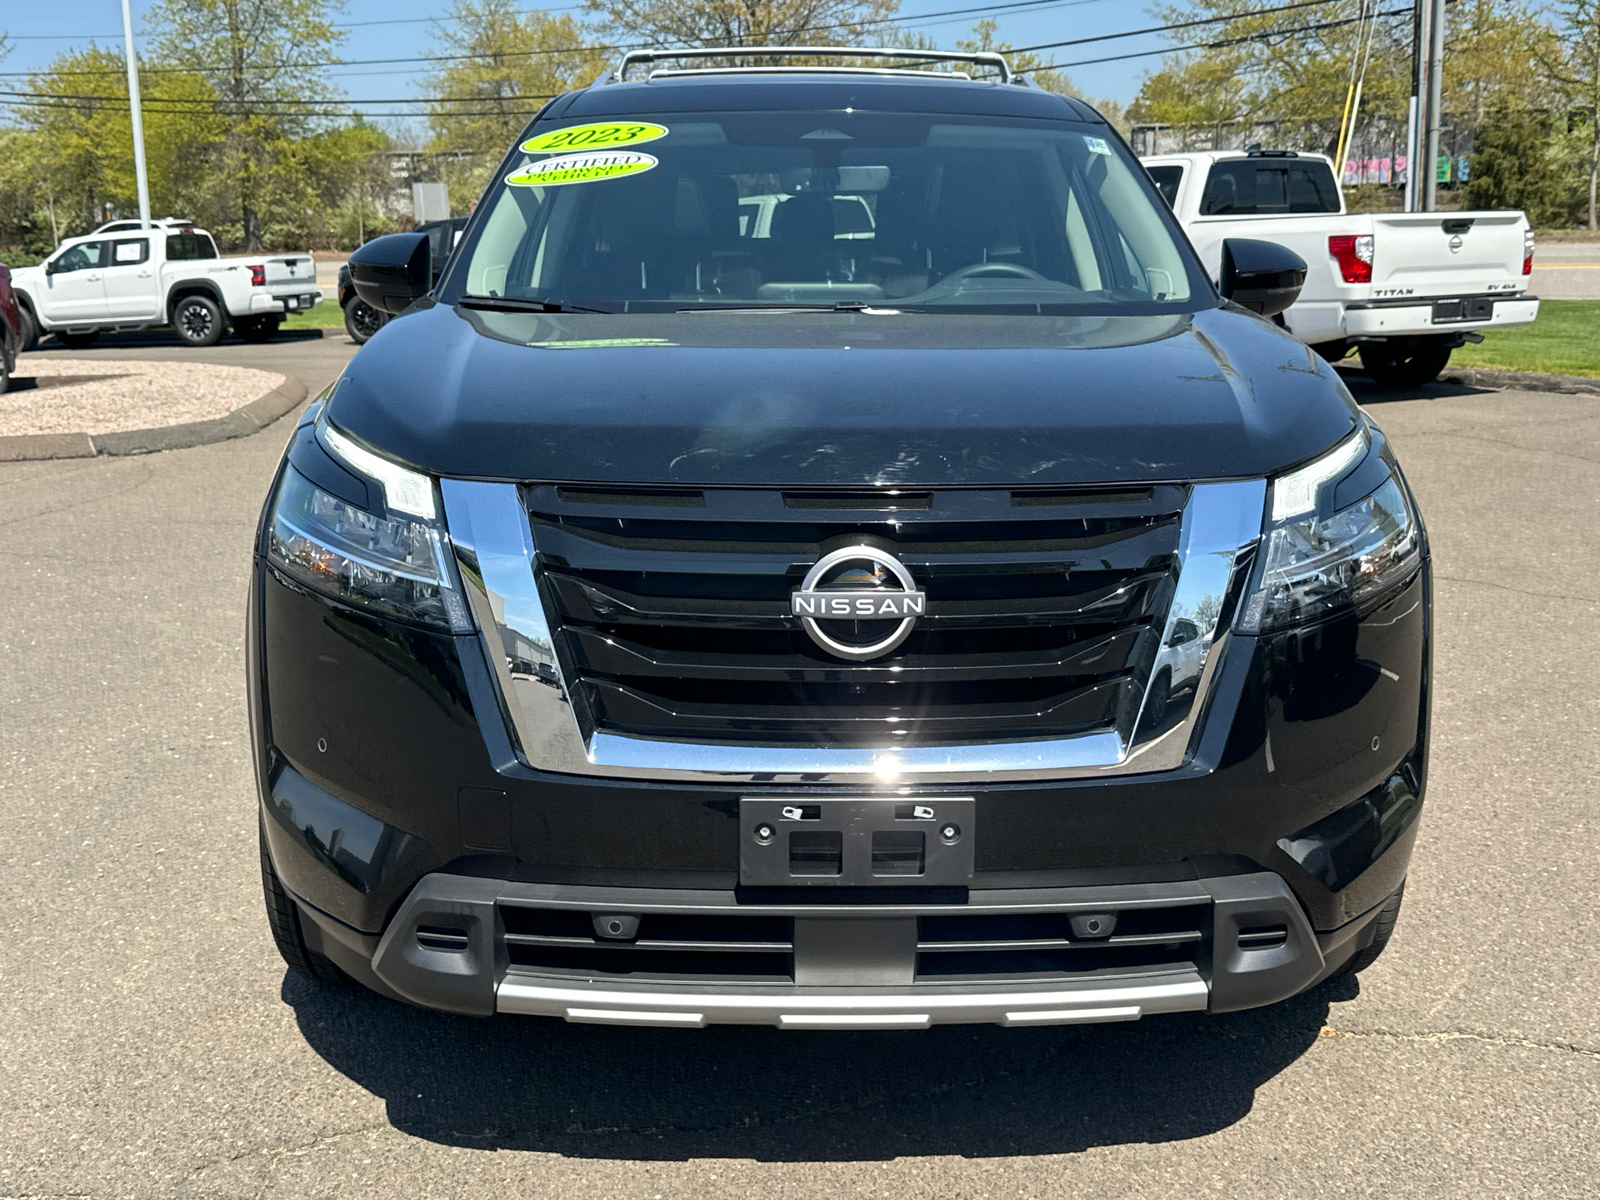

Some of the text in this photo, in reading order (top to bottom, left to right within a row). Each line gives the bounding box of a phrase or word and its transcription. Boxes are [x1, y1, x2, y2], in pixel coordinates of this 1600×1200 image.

[540, 126, 646, 150] 2023
[525, 156, 642, 175] CERTIFIED
[540, 169, 617, 182] VEHICLE
[1374, 288, 1414, 297] TITAN
[795, 597, 922, 615] NISSAN
